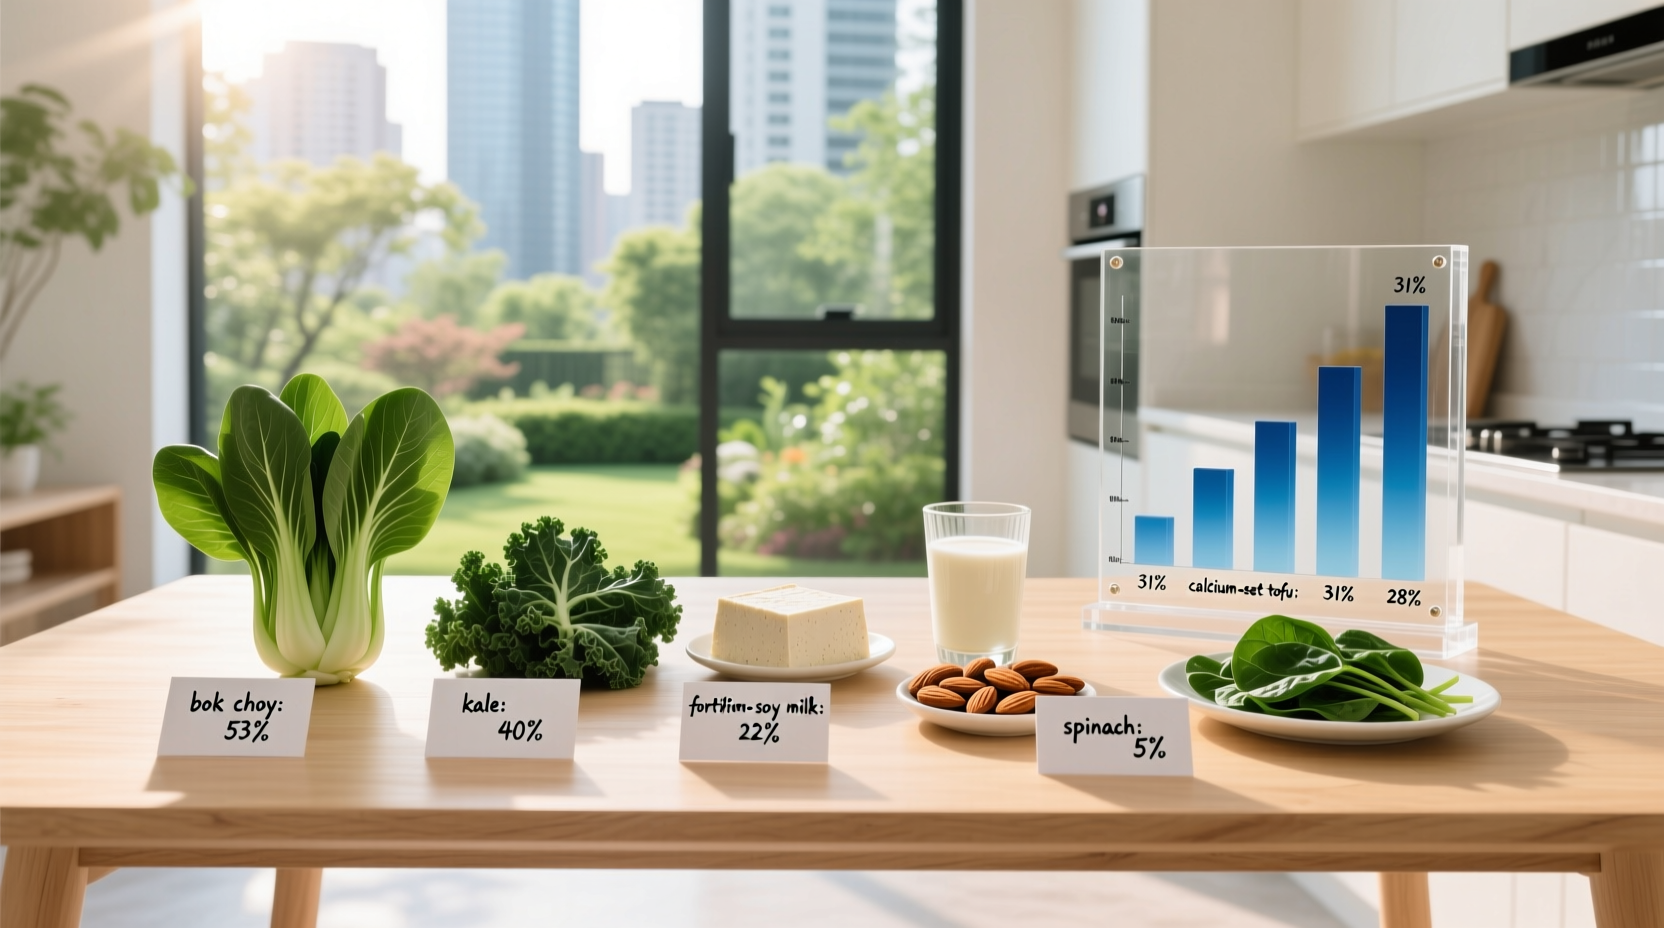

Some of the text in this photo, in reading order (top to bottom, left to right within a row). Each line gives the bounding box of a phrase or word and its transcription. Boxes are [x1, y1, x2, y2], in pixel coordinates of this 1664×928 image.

[1393, 275, 1426, 295] 31%
[1137, 573, 1167, 591] 31%
[1188, 577, 1299, 602] calcium-set tofu:
[1323, 584, 1354, 602] 31%
[1386, 588, 1421, 607] 28%
[189, 690, 283, 720] bok choy:
[462, 691, 506, 714] kale:
[786, 695, 824, 715] milk:
[223, 719, 270, 743] 53%
[497, 718, 543, 742] 40%
[738, 721, 780, 745] 22%
[1063, 714, 1142, 744] spinach:
[1133, 735, 1167, 760] 5%
